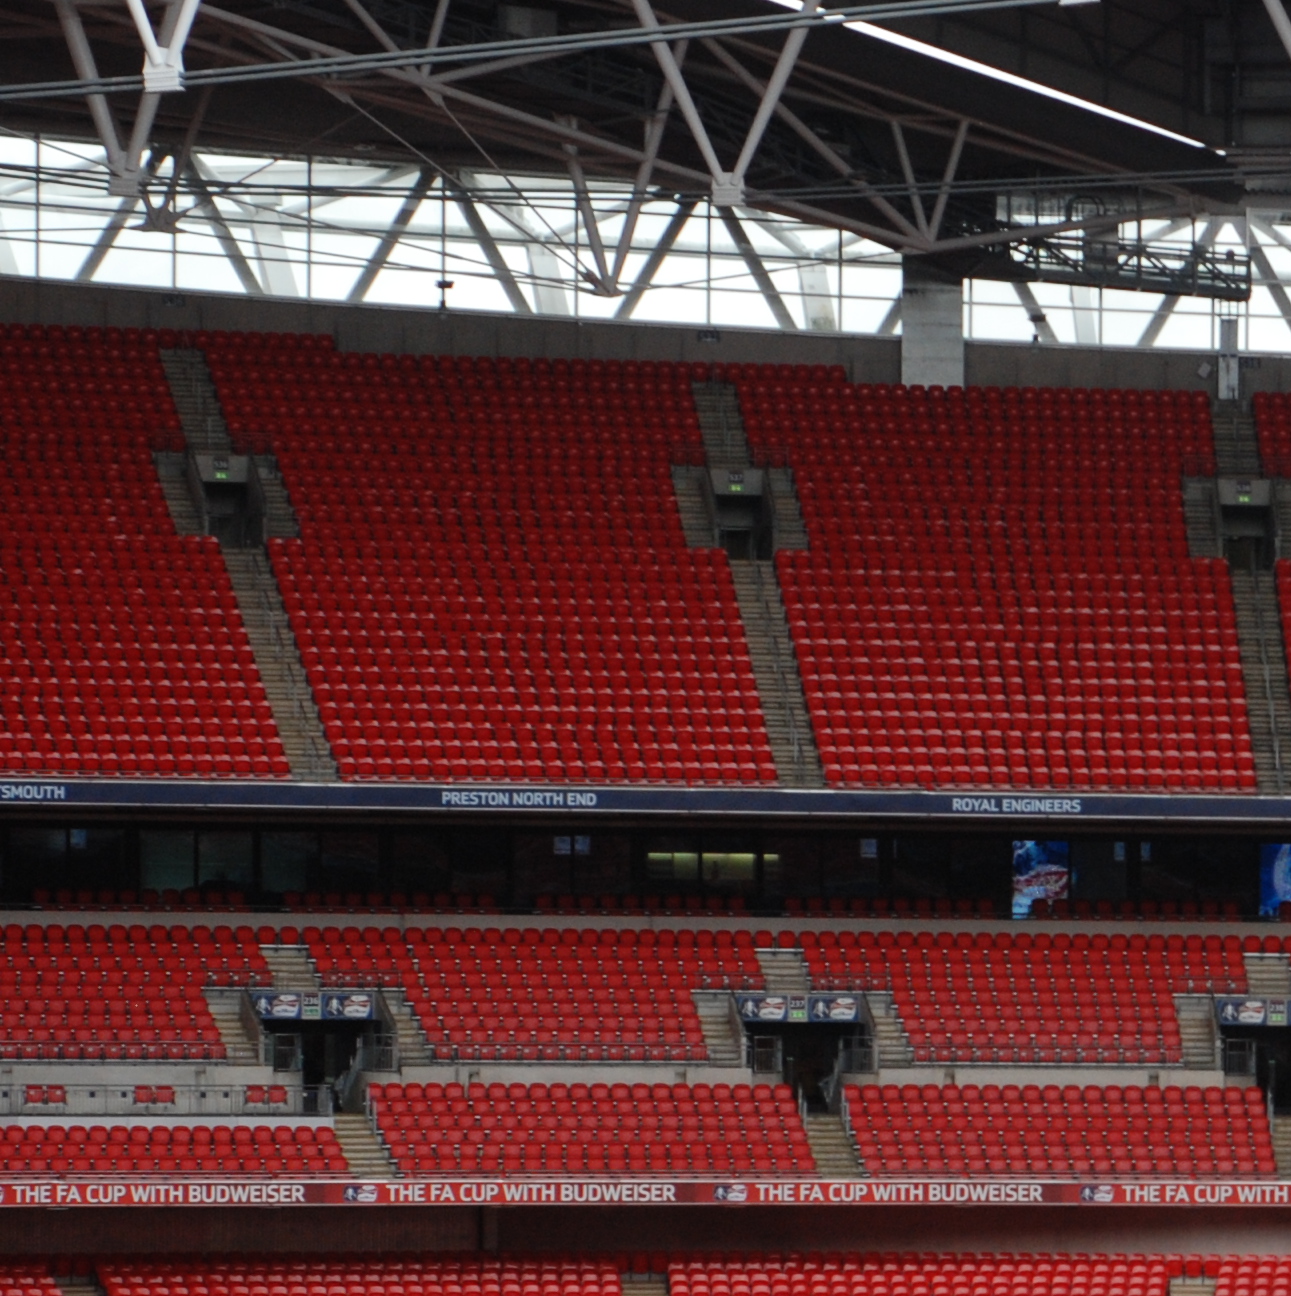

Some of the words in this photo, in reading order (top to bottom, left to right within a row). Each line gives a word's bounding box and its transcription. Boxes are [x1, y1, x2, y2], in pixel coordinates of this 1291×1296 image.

[0, 785, 65, 799] SMOUTH
[441, 792, 509, 806] PRESTON
[512, 792, 564, 806] NORTH
[567, 793, 597, 806] END
[952, 798, 999, 812] ROYAL
[1002, 799, 1081, 813] ENGINEERS
[12, 1185, 51, 1202] THE
[56, 1185, 81, 1202] FA
[86, 1185, 126, 1202] CUP
[131, 1185, 186, 1202] WITH
[188, 1185, 305, 1202] BUDWEISER
[386, 1184, 425, 1201] THE
[430, 1184, 455, 1201] FA
[459, 1184, 499, 1201] CUP
[503, 1184, 556, 1201] WITH
[560, 1184, 676, 1201] BUDWEISER
[756, 1184, 794, 1201] THE
[800, 1183, 824, 1200] FA
[829, 1184, 868, 1201] CUP
[872, 1183, 926, 1200] WITH
[930, 1184, 1042, 1201] BUDWEISER
[1122, 1185, 1161, 1202] THE
[1166, 1185, 1190, 1202] FA
[1194, 1185, 1232, 1202] CUP
[1237, 1185, 1289, 1202] WITH
